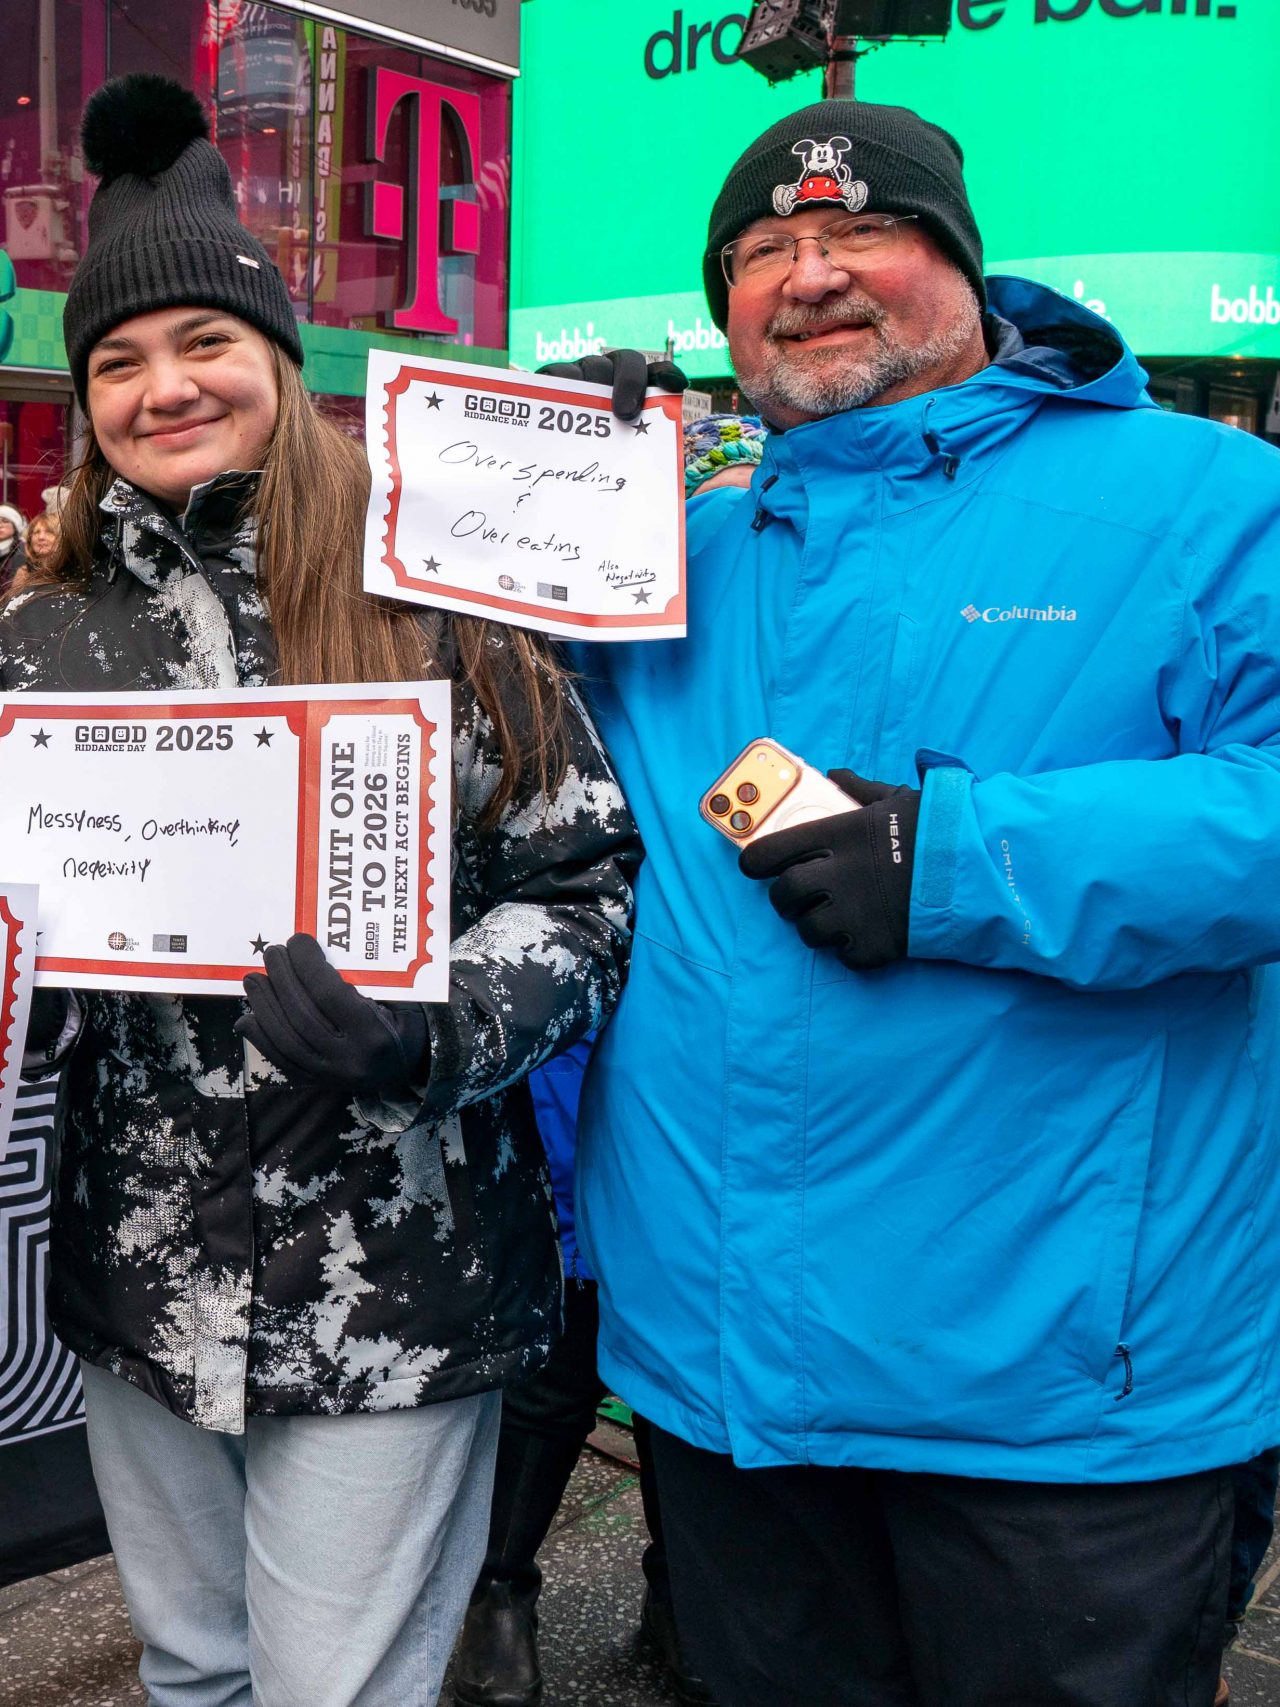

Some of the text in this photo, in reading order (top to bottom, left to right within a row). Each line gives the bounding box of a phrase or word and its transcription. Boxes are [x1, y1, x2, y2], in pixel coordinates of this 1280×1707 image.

[644, 9, 747, 80] dro
[667, 317, 726, 352] bobb
[464, 394, 611, 438] GOOD 2025
[464, 410, 530, 428] RIDDANCE DAY
[982, 605, 1078, 623] Columbia
[74, 743, 147, 752] RIDDANCE DAY
[75, 724, 234, 752] GOOD 2025
[363, 773, 388, 851] 2026
[327, 742, 355, 952] ADMIT ONE
[392, 733, 411, 953] THE NEXT ACT BEGINS
[889, 813, 902, 864] HEAD
[362, 861, 386, 912] TO
[1001, 839, 1031, 945] OMNI-TCH
